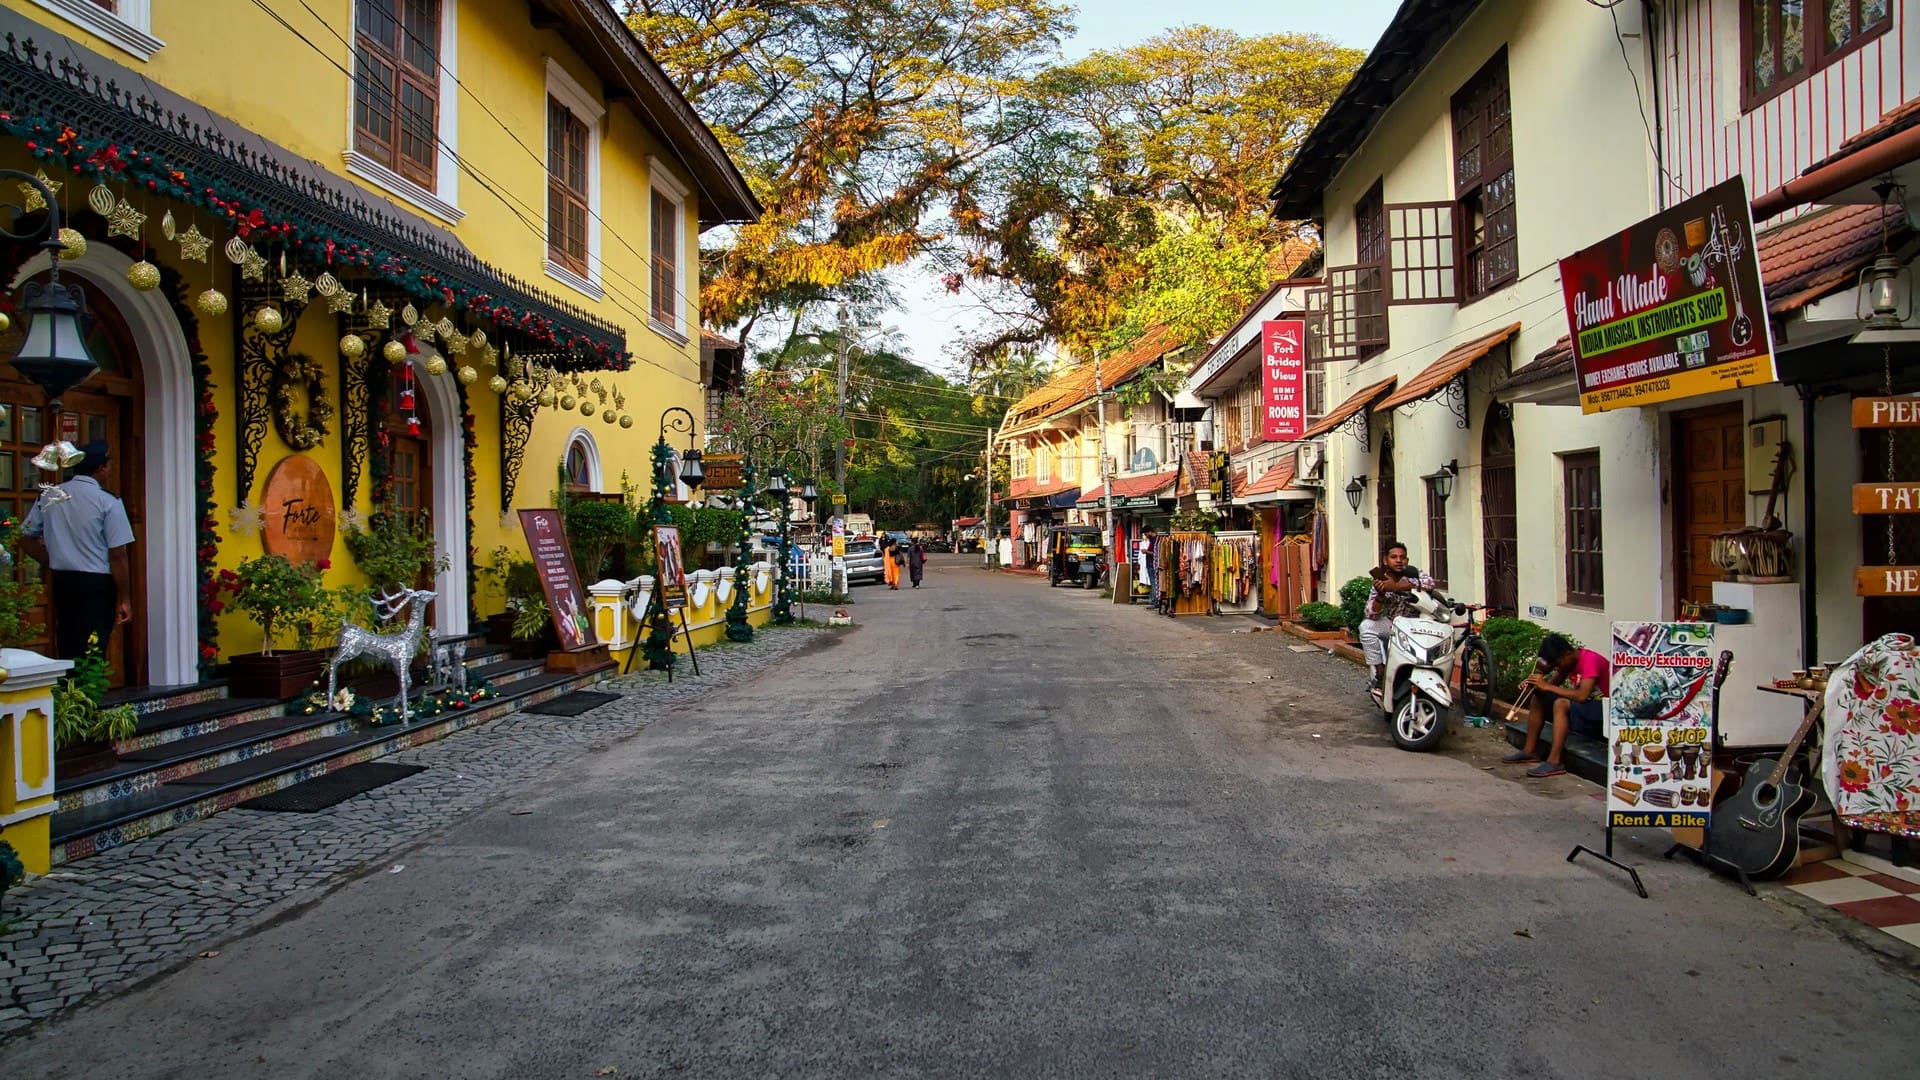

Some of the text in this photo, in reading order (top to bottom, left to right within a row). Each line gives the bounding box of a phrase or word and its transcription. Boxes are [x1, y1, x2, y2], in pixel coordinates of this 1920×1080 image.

[1574, 262, 1668, 331] Hand Made
[1580, 292, 1723, 355] INDIAN MUSICAL INSTRUMENTS SHOP
[1273, 342, 1295, 354] Fort
[1267, 354, 1301, 368] Bridge
[1584, 352, 1679, 387] MONEY EXCHANGE SERVICE AVAILABLE
[1272, 368, 1297, 380] View
[1269, 406, 1300, 418] ROOMS
[282, 498, 321, 535] Forte
[1615, 652, 1711, 670] Money Exchange
[1619, 727, 1707, 746] MUSIC SHOP
[1613, 814, 1706, 826] Rent A Bike
